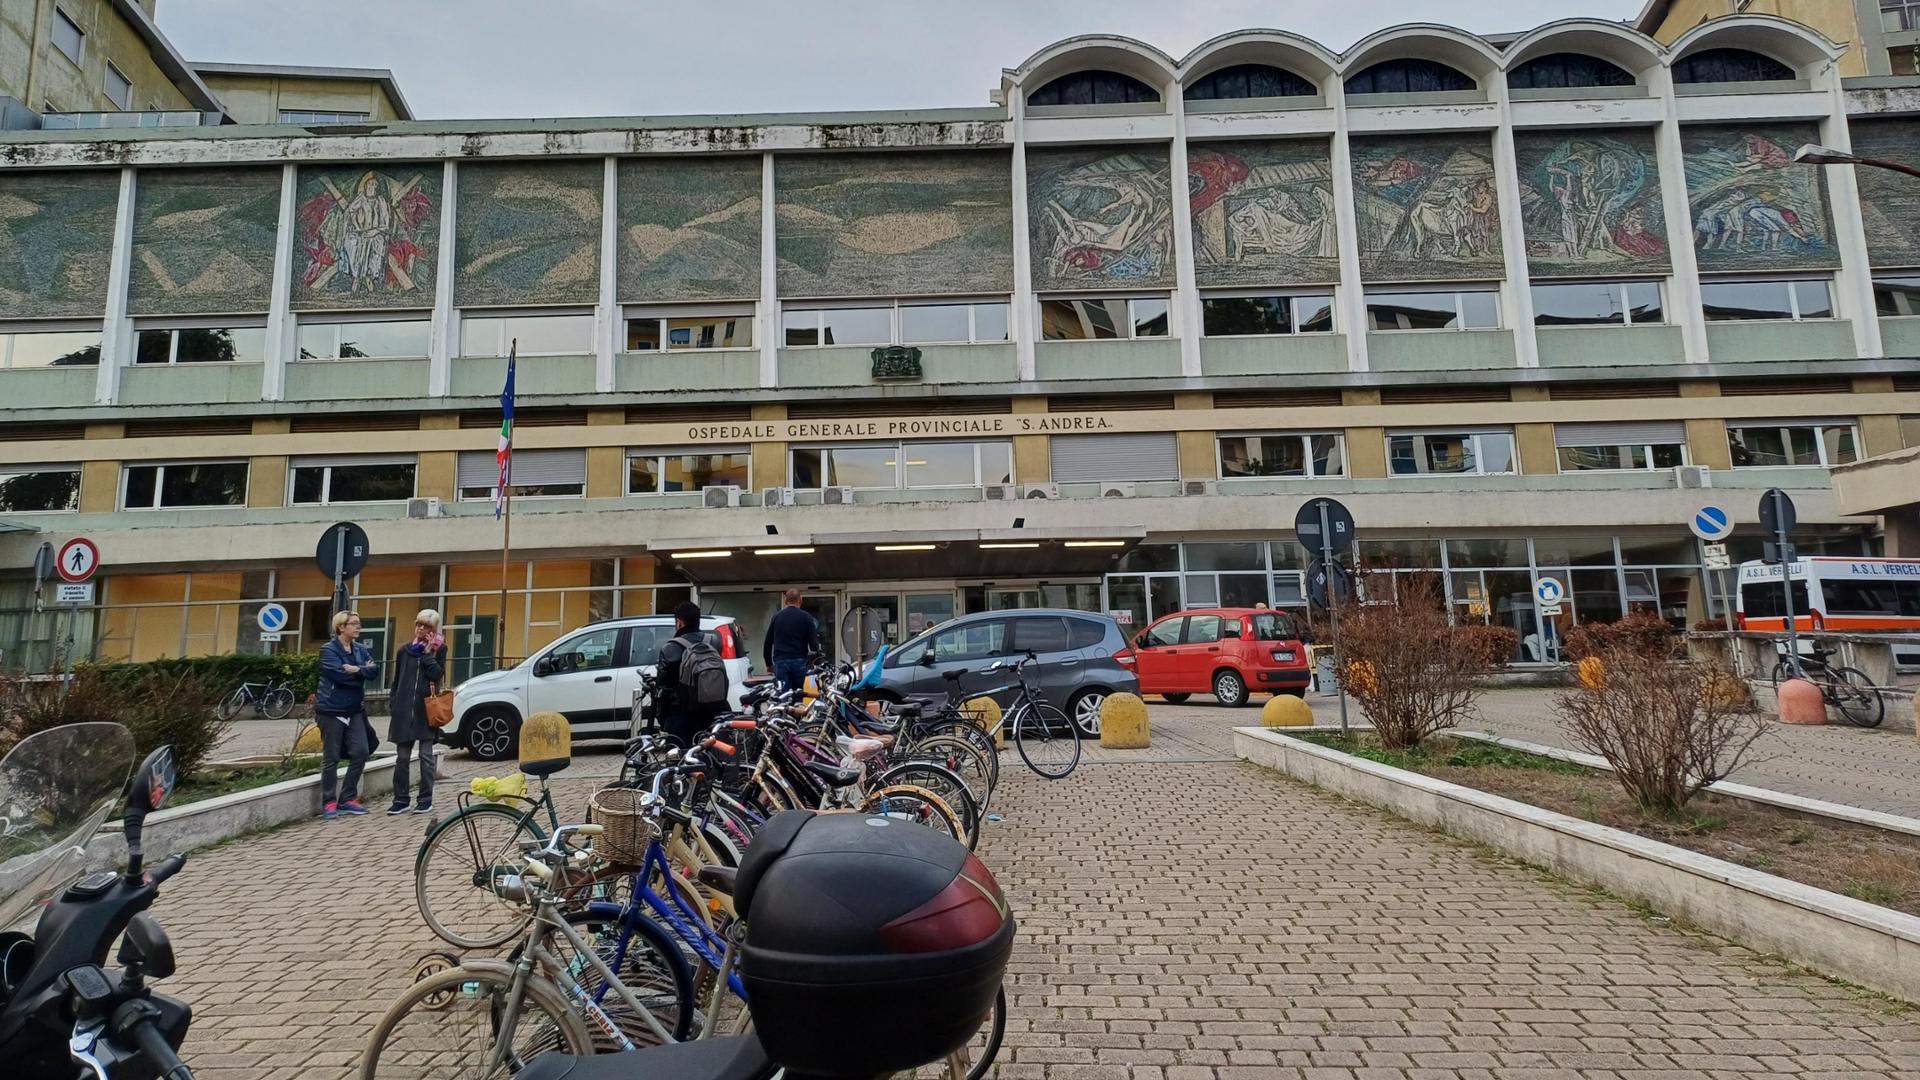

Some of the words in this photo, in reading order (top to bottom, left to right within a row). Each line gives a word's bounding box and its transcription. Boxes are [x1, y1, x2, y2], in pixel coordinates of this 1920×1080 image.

[688, 425, 775, 440] OSPEDALE
[787, 423, 877, 437] GENERALE
[888, 419, 1004, 434] PROVINCIALE
[1769, 564, 1802, 577] VERELLI
[1851, 563, 1882, 575] A.S.L.
[1882, 564, 1920, 576] VERCEL
